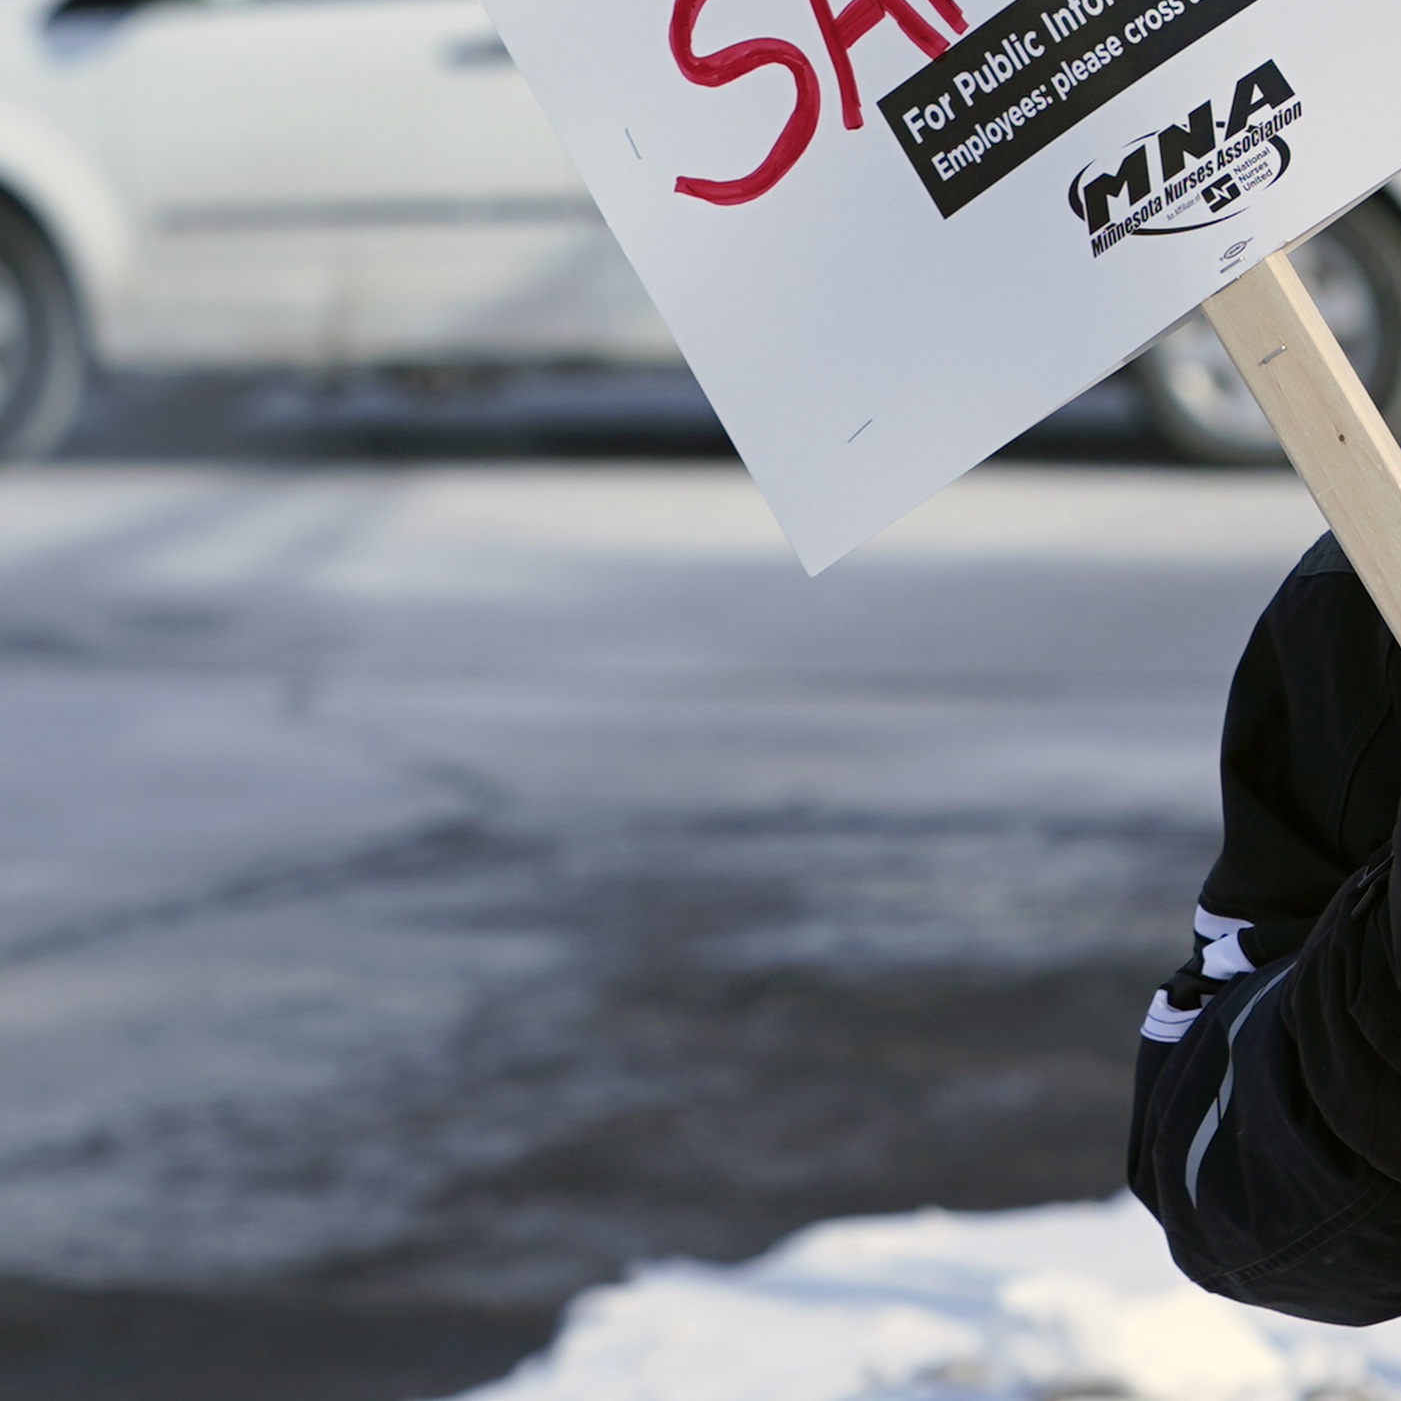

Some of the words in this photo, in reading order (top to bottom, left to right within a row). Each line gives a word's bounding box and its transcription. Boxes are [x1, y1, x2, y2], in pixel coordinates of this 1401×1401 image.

[902, 96, 955, 144] For
[953, 29, 1046, 108] Public
[930, 84, 1054, 182] Employees:
[1050, 31, 1124, 102] please
[1090, 196, 1163, 259] Minnesota
[1163, 159, 1215, 206] Nurses
[1216, 100, 1303, 171] Association
[1232, 145, 1271, 176] National
[1237, 160, 1269, 184] Nurses
[1242, 168, 1274, 192] United
